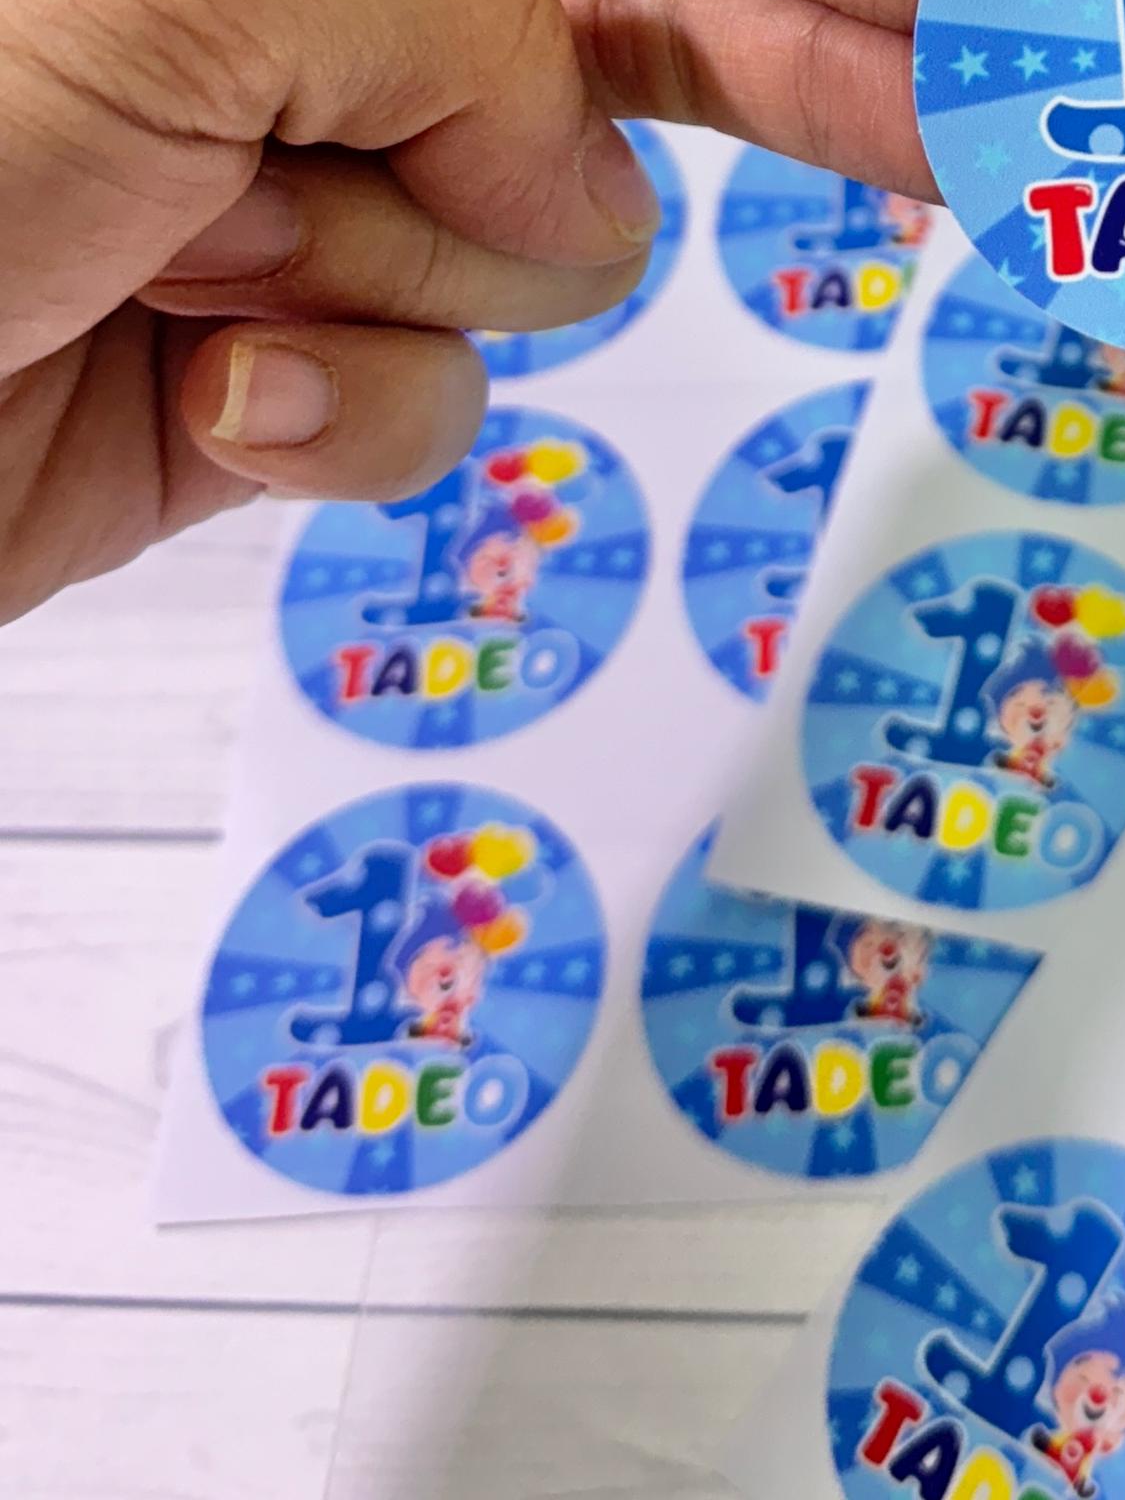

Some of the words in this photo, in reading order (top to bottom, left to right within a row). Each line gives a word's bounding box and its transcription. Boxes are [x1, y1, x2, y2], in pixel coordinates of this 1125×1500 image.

[773, 262, 915, 318] TAD
[335, 629, 581, 705] TADEO
[880, 578, 1022, 768] 1
[850, 762, 1105, 877] TADEO
[286, 840, 426, 1049] 1
[263, 1054, 530, 1136] TADEO
[711, 1034, 983, 1120] TADEO
